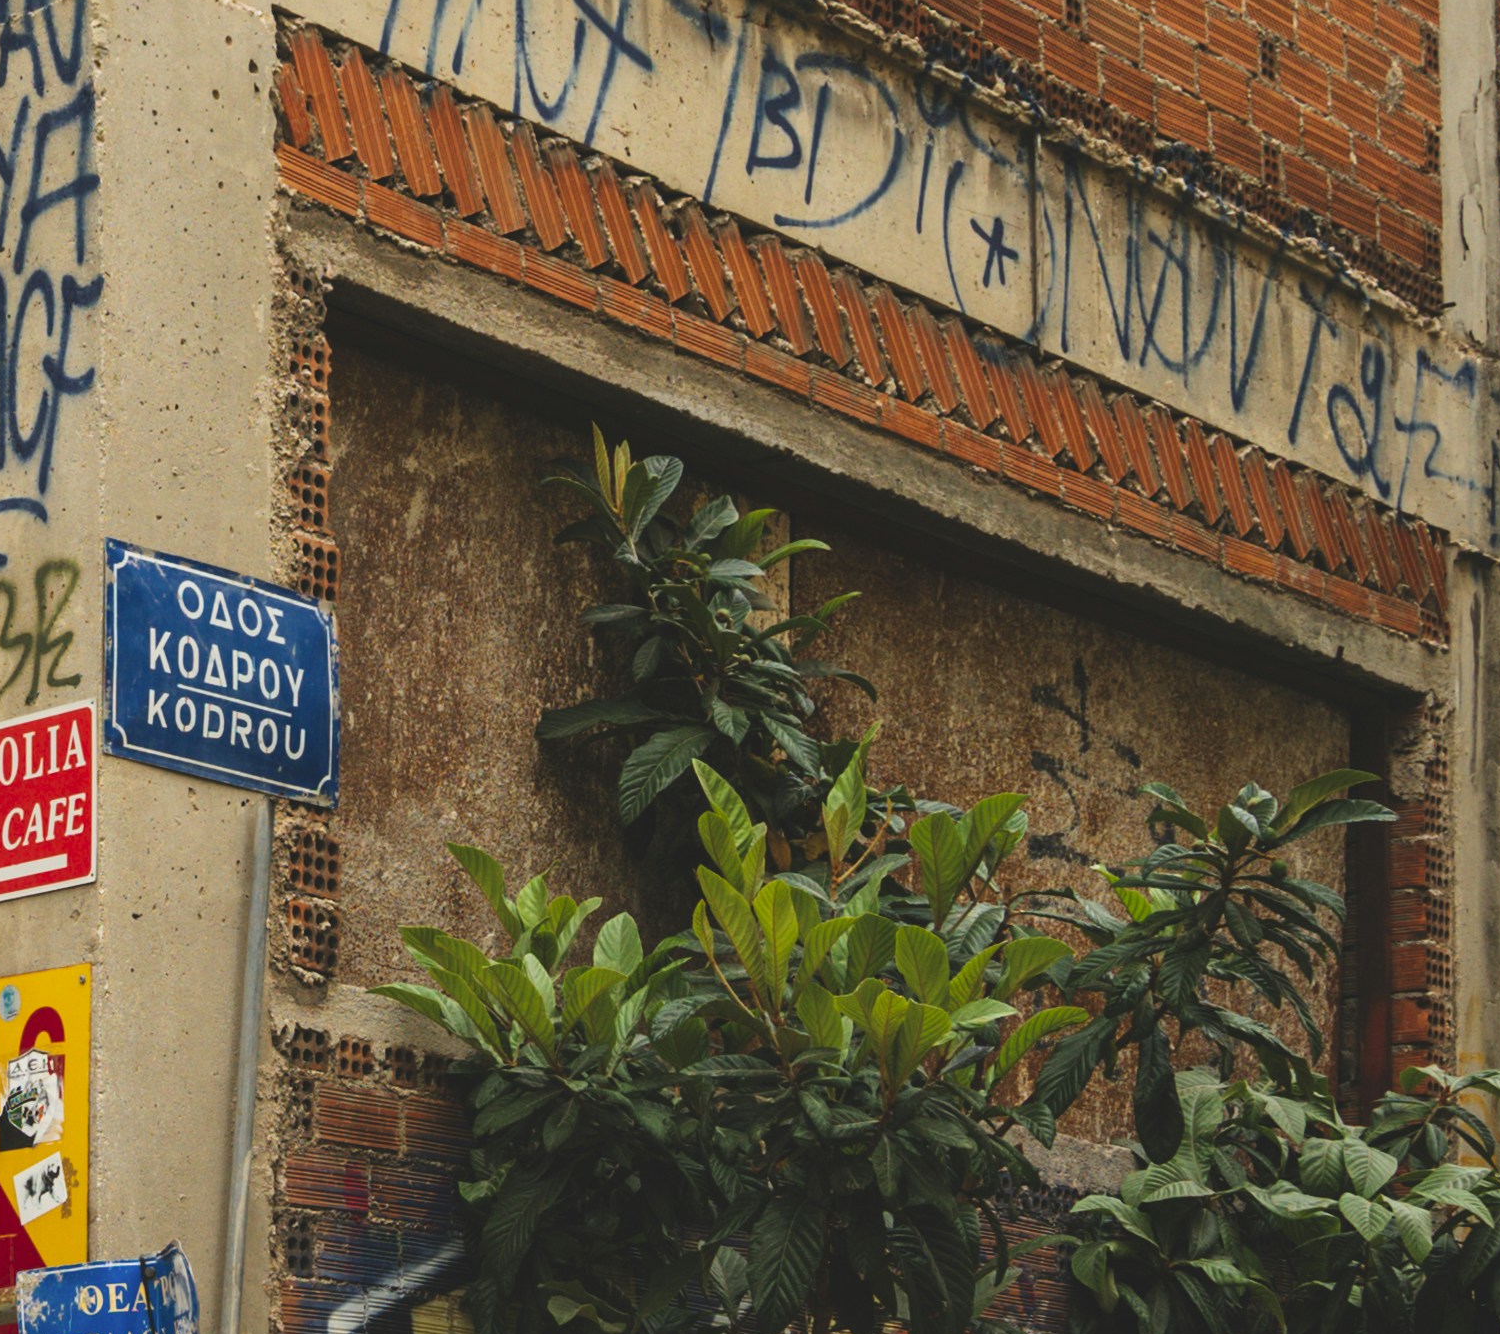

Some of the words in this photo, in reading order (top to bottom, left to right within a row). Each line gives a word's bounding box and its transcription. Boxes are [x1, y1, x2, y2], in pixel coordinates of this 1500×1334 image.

[177, 578, 288, 647] ΟΔΟΣ
[149, 625, 306, 709] ΚΟΔΡΟΥ
[147, 688, 307, 762] KODROU
[1, 791, 88, 853] CAFE
